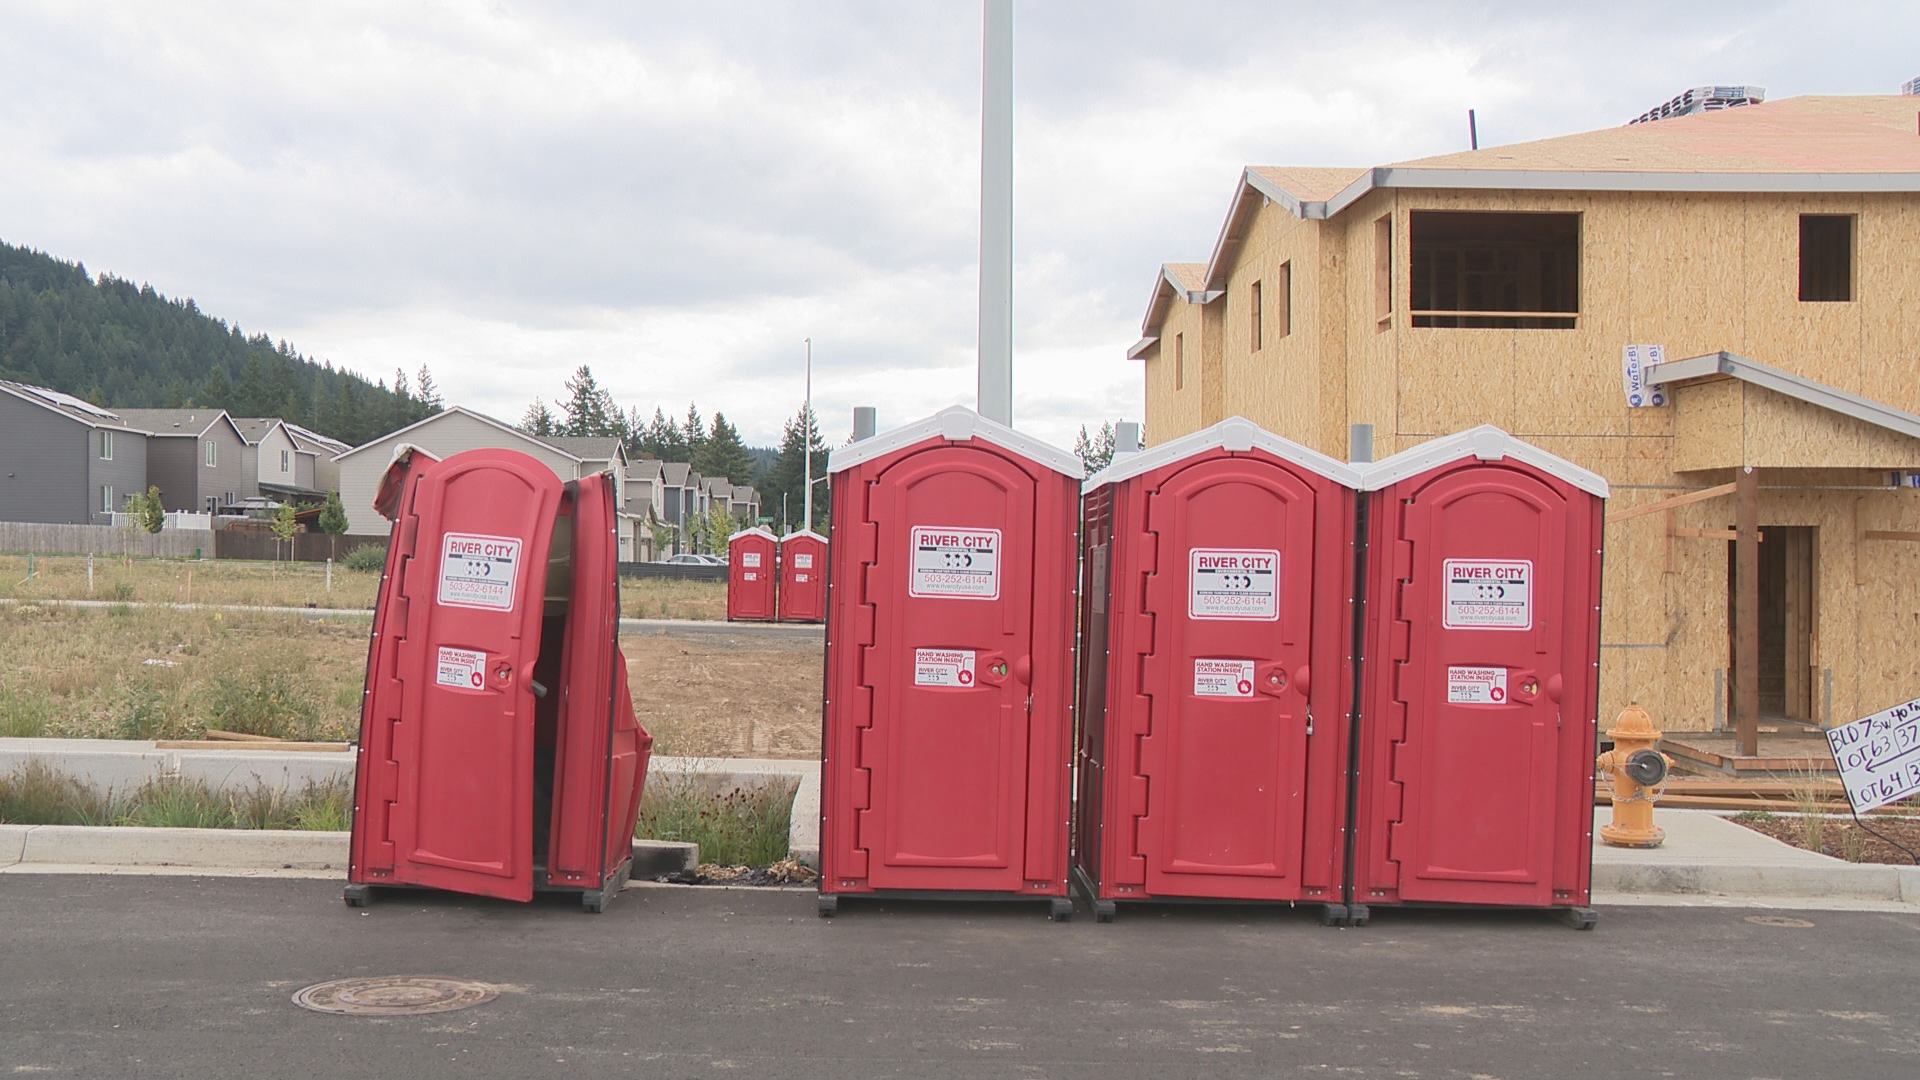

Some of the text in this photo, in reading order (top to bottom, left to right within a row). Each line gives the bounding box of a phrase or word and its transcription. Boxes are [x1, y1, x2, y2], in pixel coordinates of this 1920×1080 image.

[920, 534, 992, 548] RIVER CITY
[450, 541, 513, 557] RIVER CITY
[1199, 556, 1271, 568] RIVER CITY
[924, 574, 987, 584] 503-252-6144
[1453, 567, 1524, 579] RIVER CITY
[449, 582, 503, 594] 503-252-6144
[1204, 596, 1267, 605] 503-252-6144
[1458, 606, 1520, 615] 503-252-6144
[1828, 725, 1859, 754] BLD
[1858, 718, 1872, 738] 7
[1872, 719, 1891, 735] SW
[1837, 744, 1870, 773] LOT
[1871, 736, 1891, 757] 63
[1849, 782, 1878, 808] LOT
[1880, 771, 1903, 796] 64
